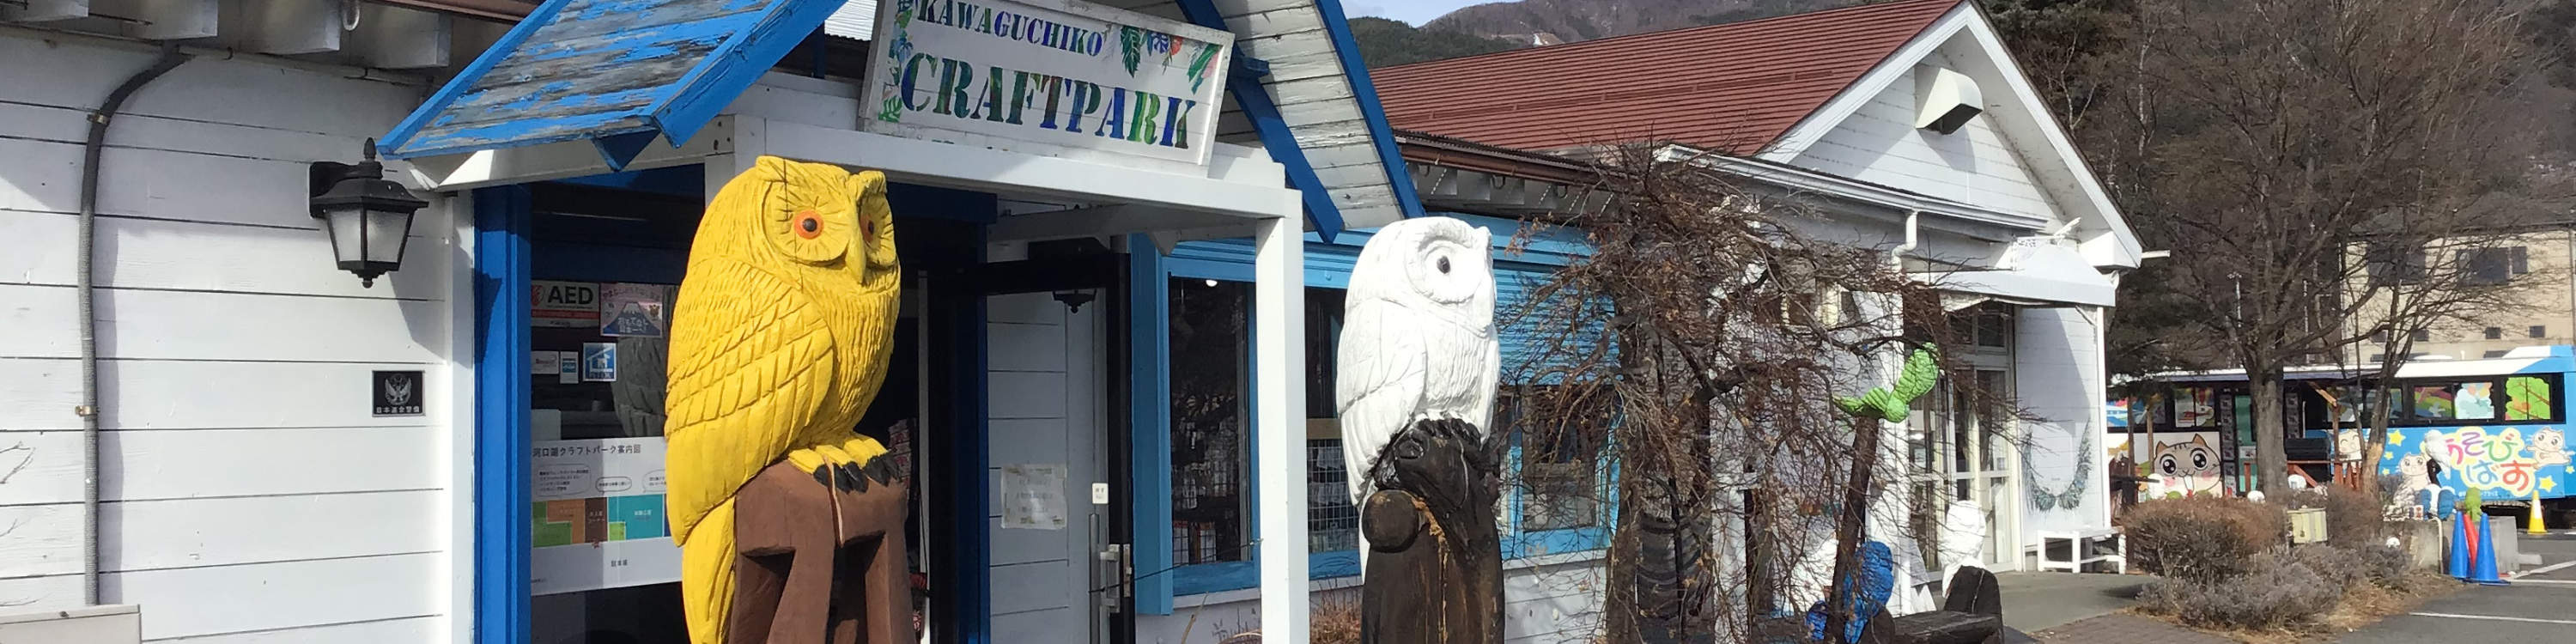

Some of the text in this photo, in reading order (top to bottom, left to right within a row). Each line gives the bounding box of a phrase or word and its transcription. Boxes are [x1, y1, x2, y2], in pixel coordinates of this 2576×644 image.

[917, 0, 1104, 58] KAWAGUCHIKO
[900, 52, 1196, 149] CRAFTPARK
[547, 285, 593, 304] AED
[532, 444, 641, 458] 河口湖クラフトパーク案内図
[2465, 459, 2532, 492] ばす
